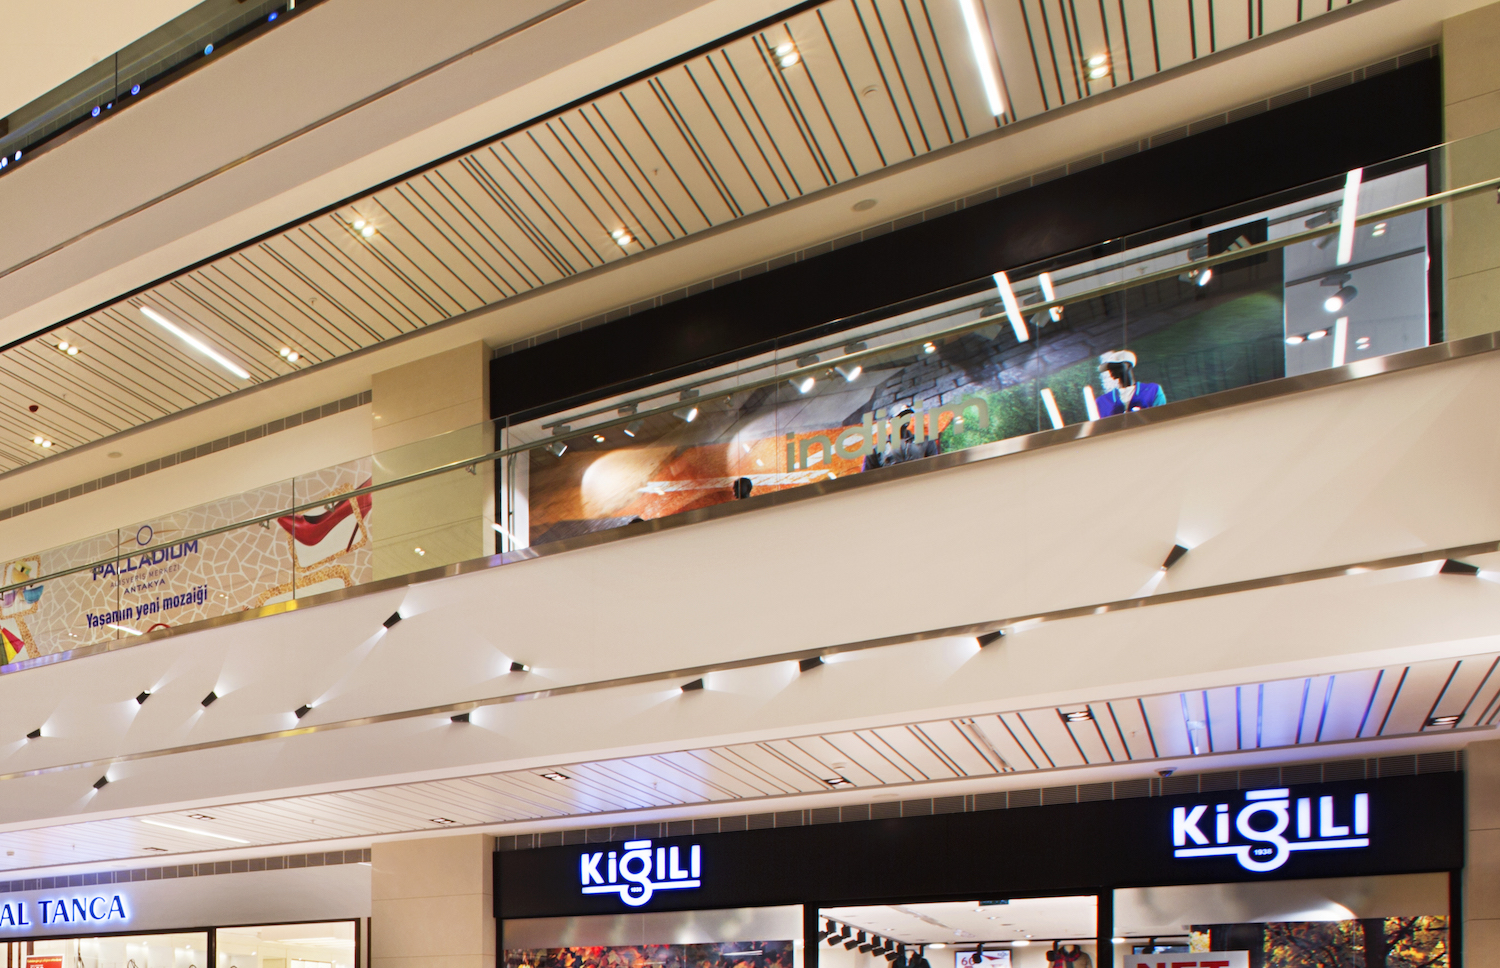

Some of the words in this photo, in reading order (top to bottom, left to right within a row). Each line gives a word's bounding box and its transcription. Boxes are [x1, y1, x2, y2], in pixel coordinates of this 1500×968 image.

[786, 398, 990, 473] indirim
[92, 540, 198, 580] PALLADIUM
[86, 607, 133, 629] Yaşamın
[136, 597, 160, 620] yeni
[162, 584, 208, 610] mozaiği
[124, 579, 165, 595] ANTAKYA
[38, 895, 126, 923] TANCA
